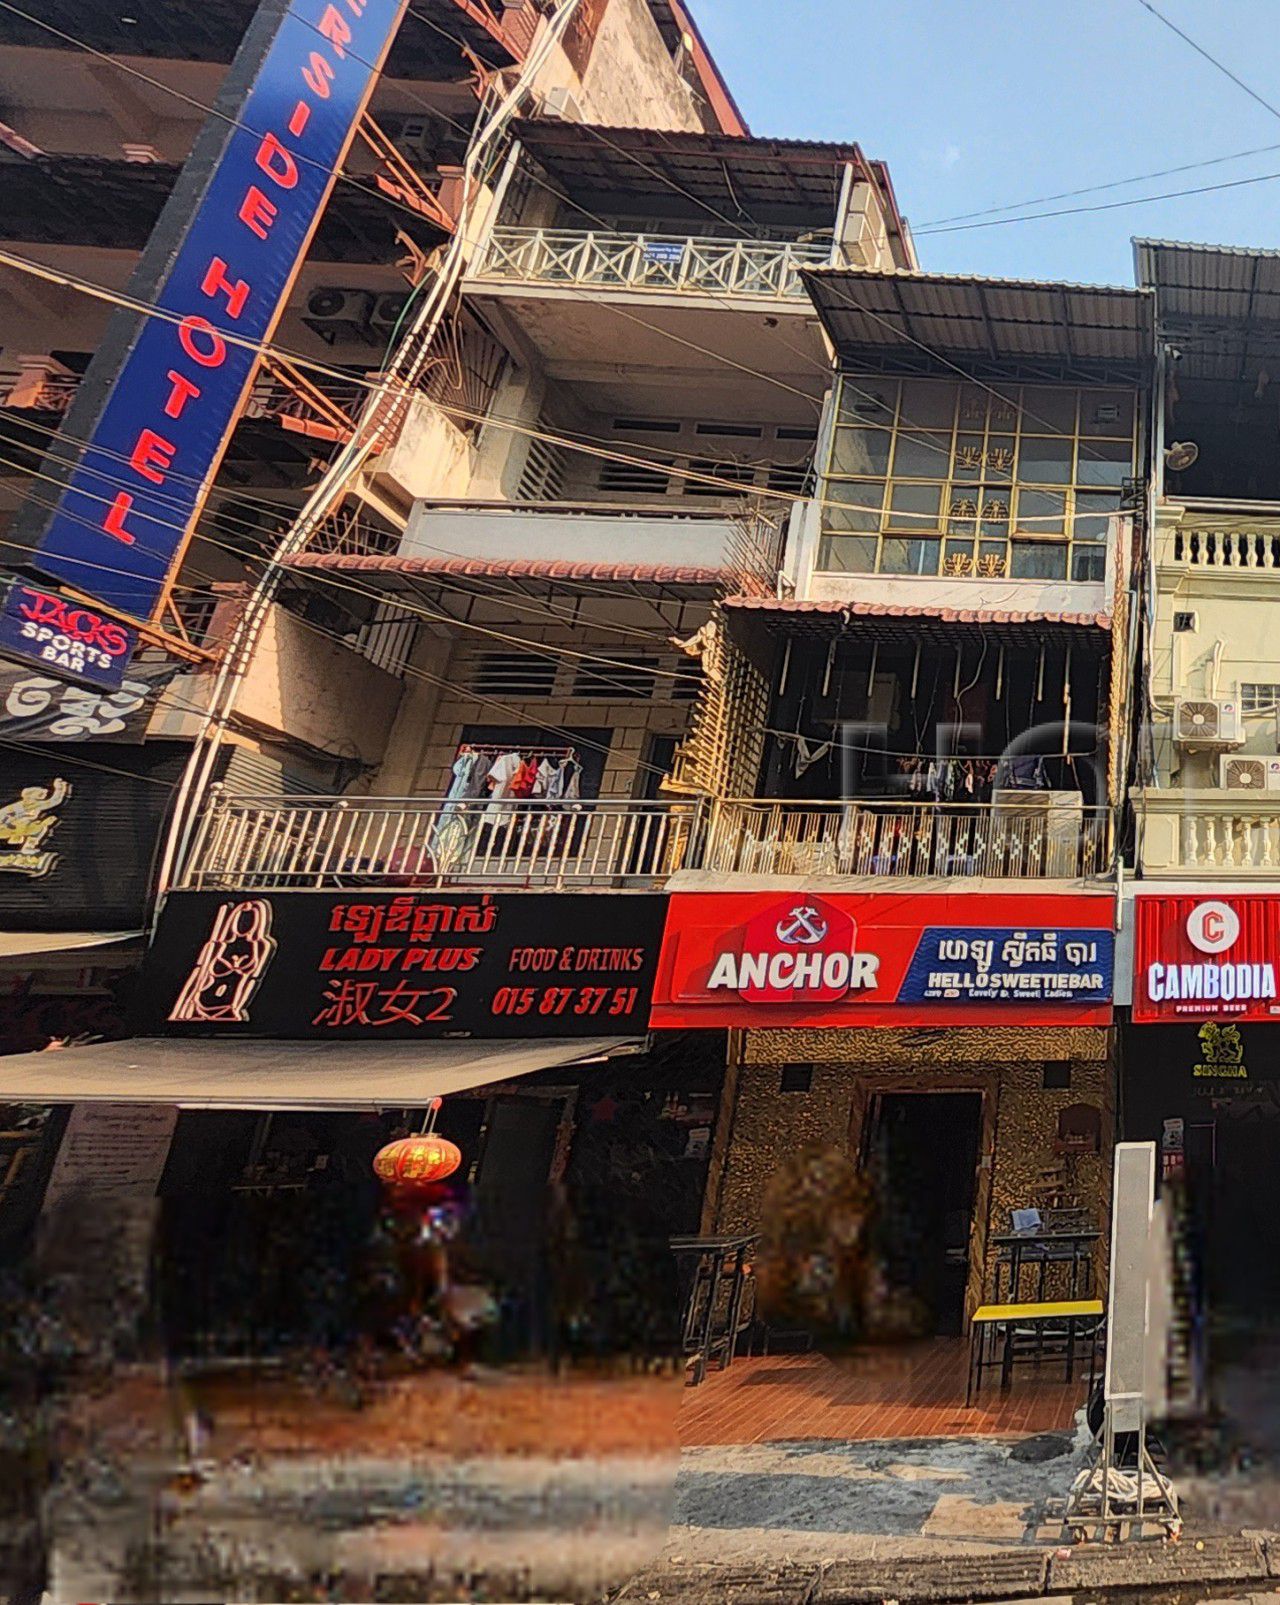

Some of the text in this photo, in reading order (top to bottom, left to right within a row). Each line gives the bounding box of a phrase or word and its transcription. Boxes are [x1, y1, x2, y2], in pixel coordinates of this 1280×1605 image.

[238, 0, 367, 240] RSIDE
[102, 257, 250, 544] HOTEL
[21, 622, 113, 669] SPORTS
[41, 646, 86, 673] BAR
[318, 947, 485, 972] LADY PLUS
[508, 946, 645, 972] FOOD & DRINKS
[706, 951, 880, 990] ANCHOR
[1148, 962, 1277, 1002] CAMBODIA
[312, 979, 458, 1027] 淑女2
[491, 987, 639, 1015] 015 87 37 51
[1176, 1004, 1219, 1013] PREMIUM
[1193, 1064, 1249, 1079] SINGHA
